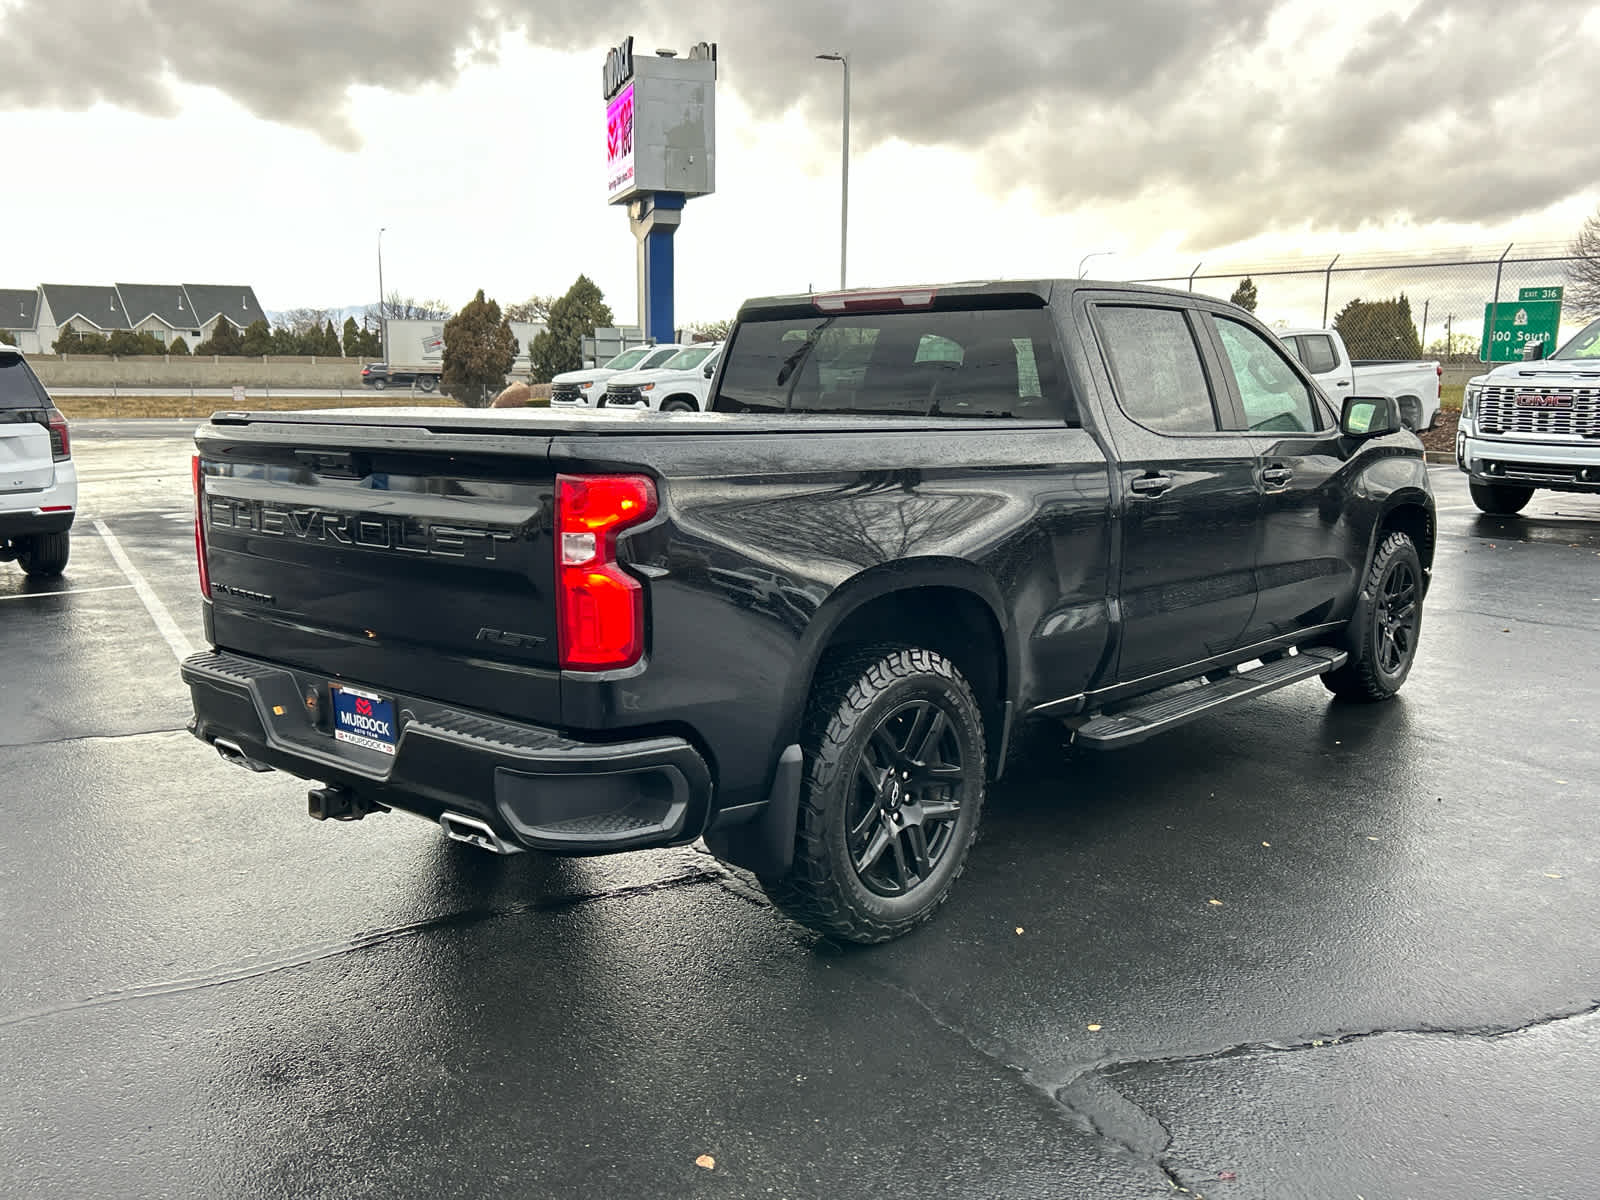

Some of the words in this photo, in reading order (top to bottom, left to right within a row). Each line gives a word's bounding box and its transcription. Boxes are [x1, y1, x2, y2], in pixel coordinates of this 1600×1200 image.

[1542, 289, 1557, 298] 316
[1517, 331, 1551, 341] South
[1516, 395, 1571, 407] GMC
[208, 499, 512, 560] CHEVROLET
[341, 710, 390, 736] MURDOCK
